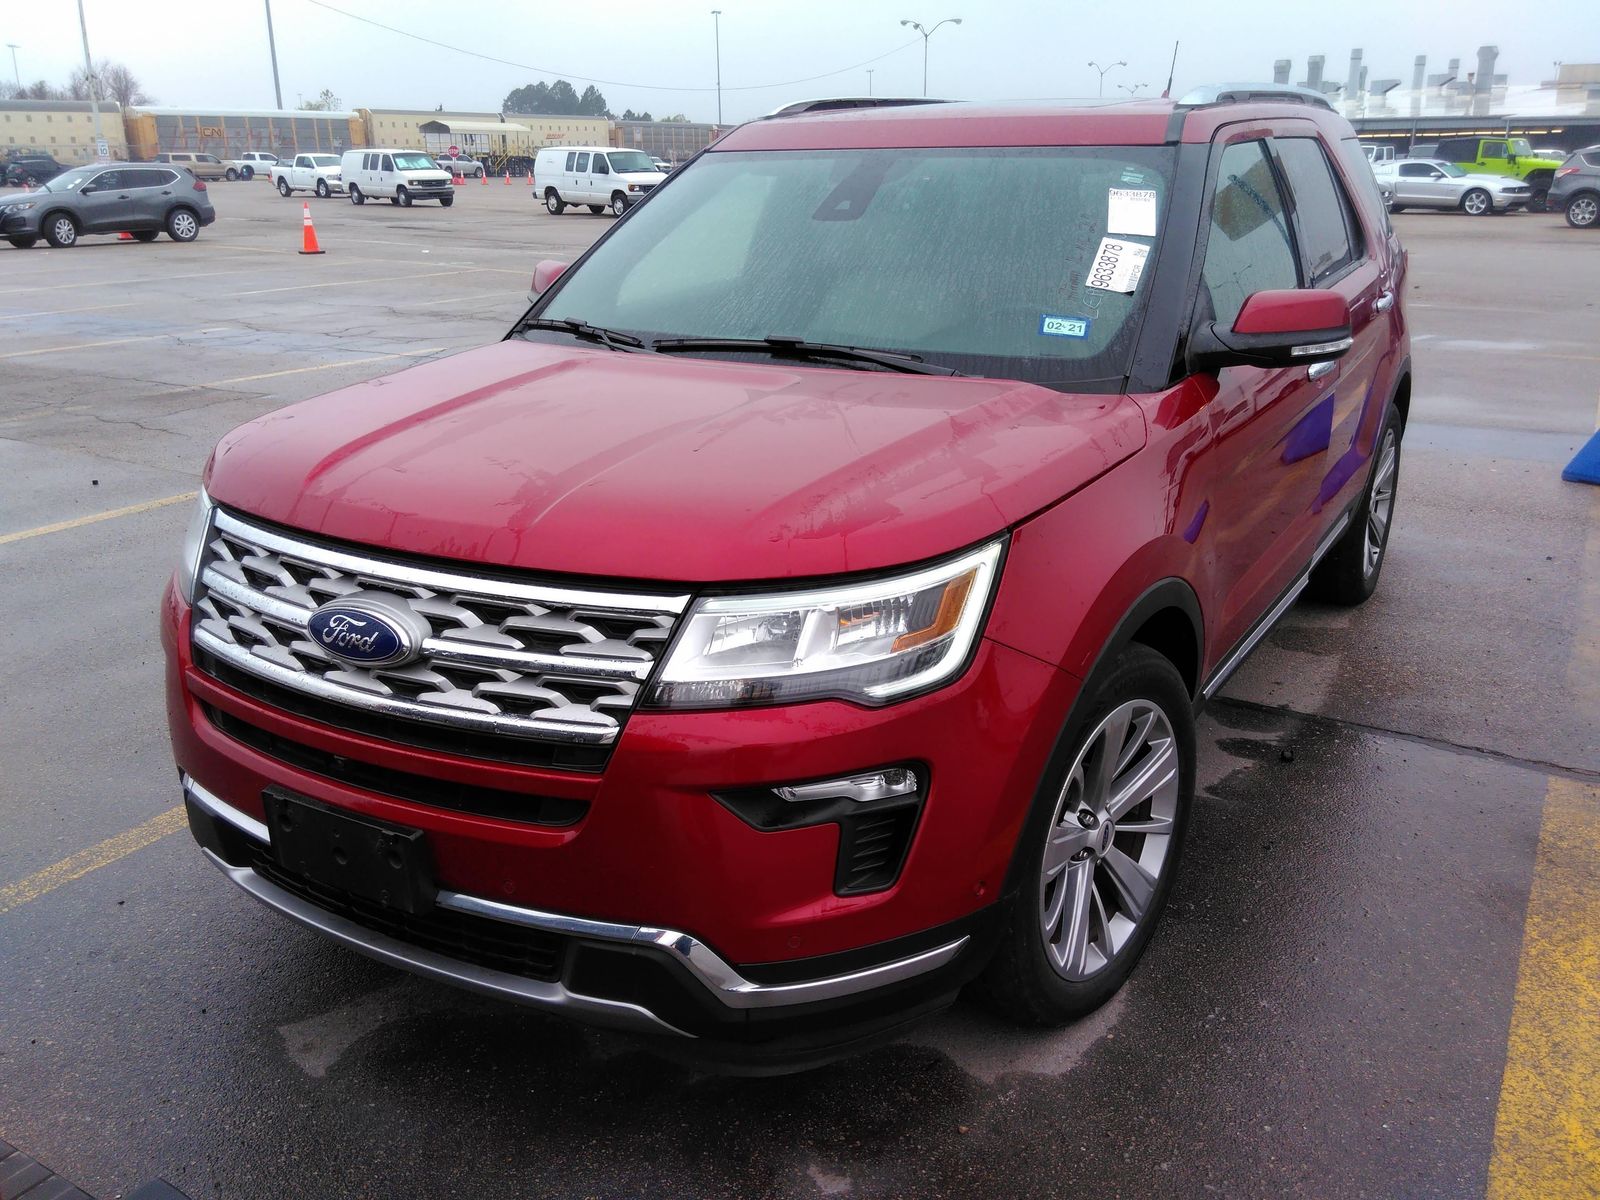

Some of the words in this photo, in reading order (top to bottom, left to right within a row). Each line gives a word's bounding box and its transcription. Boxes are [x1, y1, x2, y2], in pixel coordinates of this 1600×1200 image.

[203, 127, 221, 136] CN
[1110, 190, 1155, 199] 9633878
[1091, 244, 1123, 288] 9633878
[1047, 321, 1062, 330] 02
[1068, 324, 1082, 333] 21
[323, 614, 379, 653] Ford
